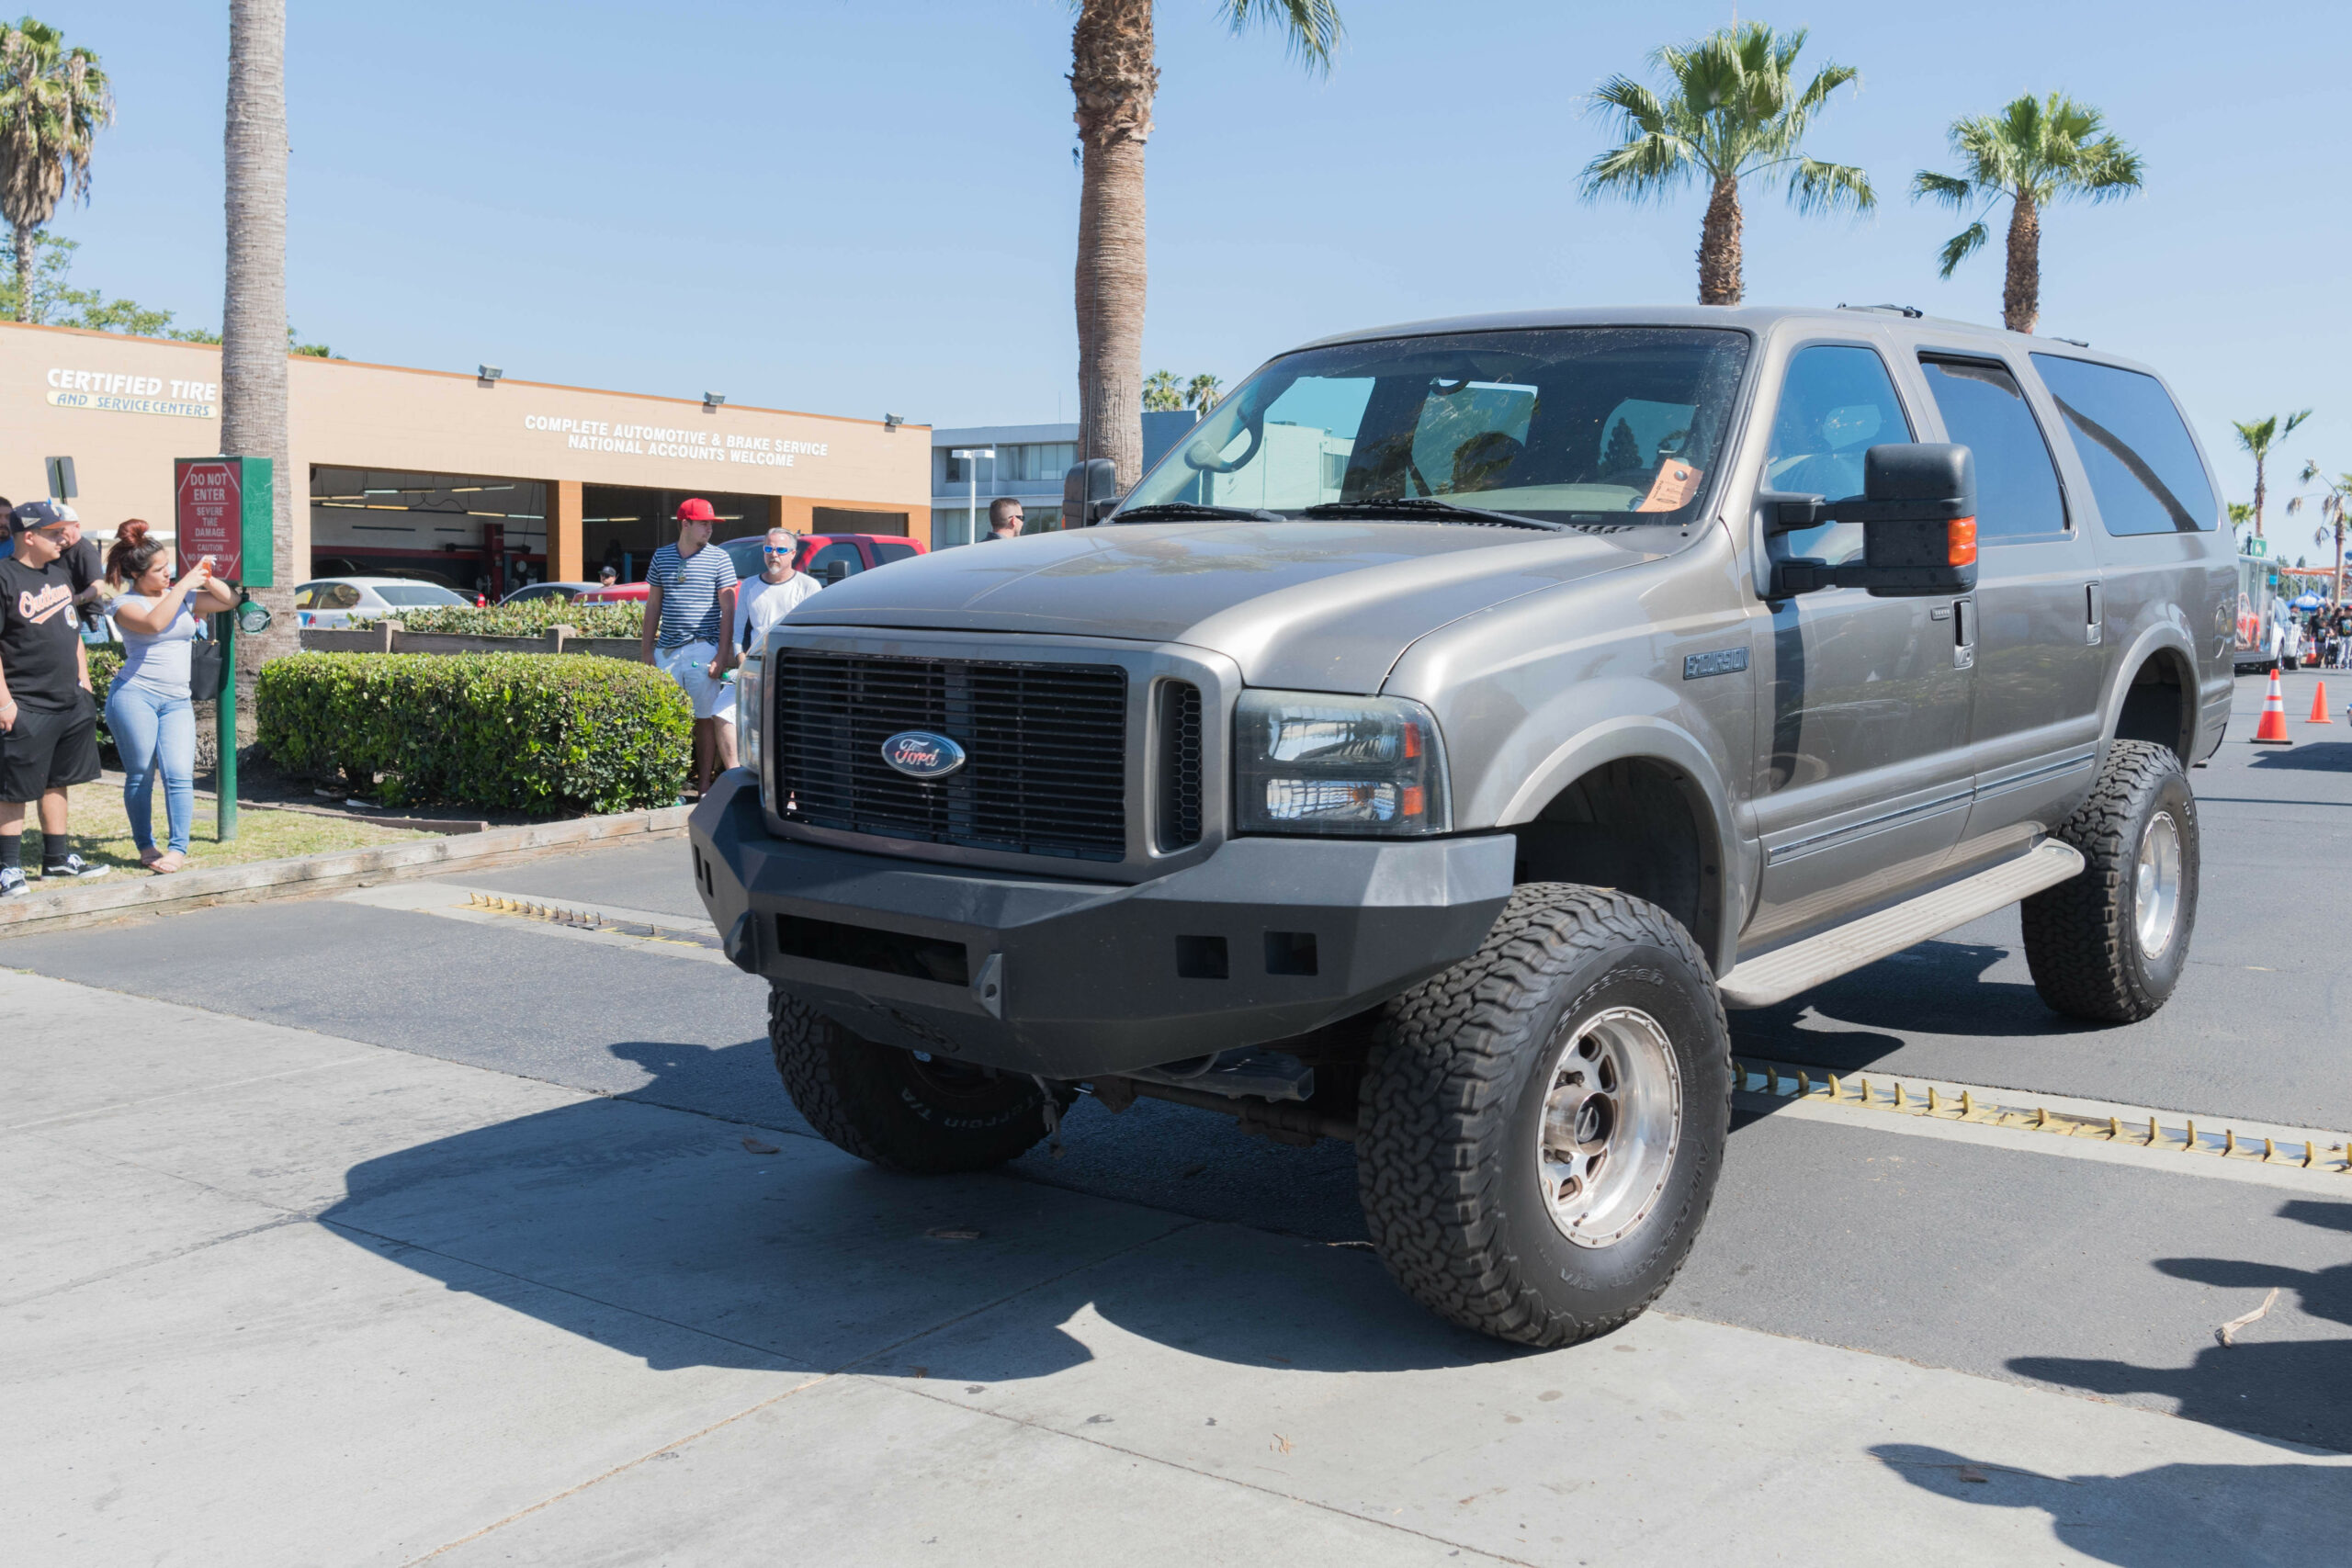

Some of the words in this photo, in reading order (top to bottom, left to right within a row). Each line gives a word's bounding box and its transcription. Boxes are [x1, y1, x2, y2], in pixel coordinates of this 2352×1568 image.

[47, 368, 163, 396] CERTIFIED
[170, 379, 218, 402] TIRE
[57, 393, 88, 406] AND
[97, 396, 150, 412] SERVICE
[153, 401, 209, 417] CENTERS
[525, 415, 608, 436] COMPLETE
[614, 423, 707, 446] AUTOMOTIVE
[711, 433, 721, 446] &
[726, 434, 770, 451] BRAKE
[775, 439, 829, 457] SERVICE
[568, 434, 643, 455] NATIONAL
[647, 441, 725, 462] ACCOUNTS
[729, 449, 794, 467] WELCOME
[190, 473, 205, 486] DO
[208, 473, 227, 486] NOT
[194, 489, 225, 501] ENTER
[197, 507, 223, 515] SEVERE
[202, 517, 218, 526] TIRE
[195, 528, 225, 536] DAMAGE
[1687, 648, 1749, 677] EXCURSION
[895, 739, 940, 766] Ford
